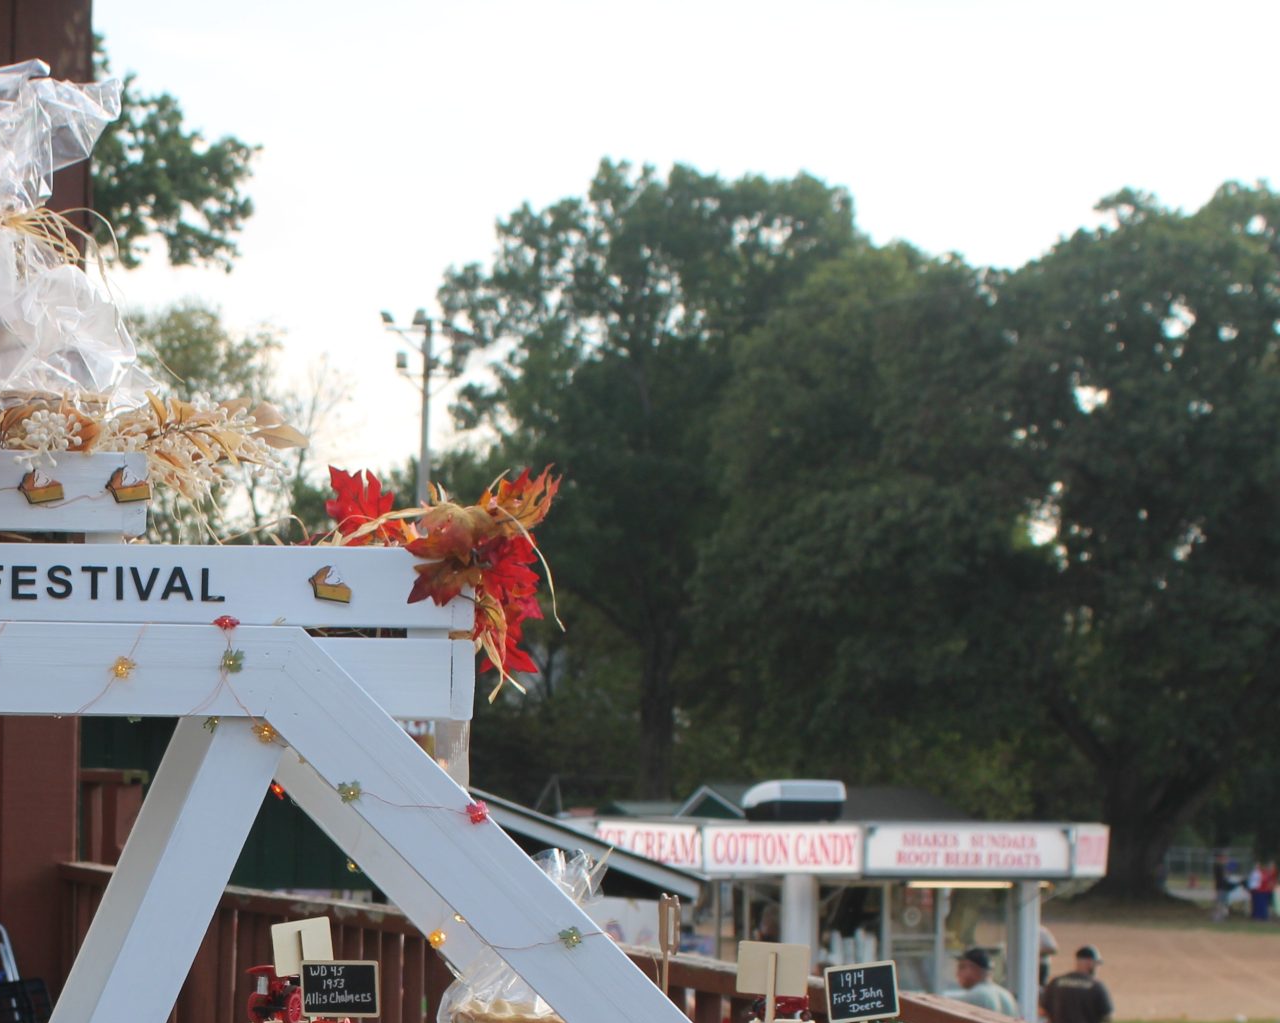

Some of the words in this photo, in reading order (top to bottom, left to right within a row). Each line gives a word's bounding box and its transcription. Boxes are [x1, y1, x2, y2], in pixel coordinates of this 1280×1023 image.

[631, 831, 696, 864] CREAM
[713, 831, 789, 865] COTTON
[795, 832, 858, 866] CANDY
[896, 851, 938, 865] ROOT
[945, 852, 982, 866] BEER
[988, 853, 1041, 868] FLOATS
[309, 966, 327, 977] WD
[330, 966, 344, 976] 45
[840, 970, 864, 987] 1914
[322, 978, 345, 989] 1953
[832, 989, 857, 1005] First
[859, 987, 883, 1001] John
[849, 1000, 884, 1013] Deere
